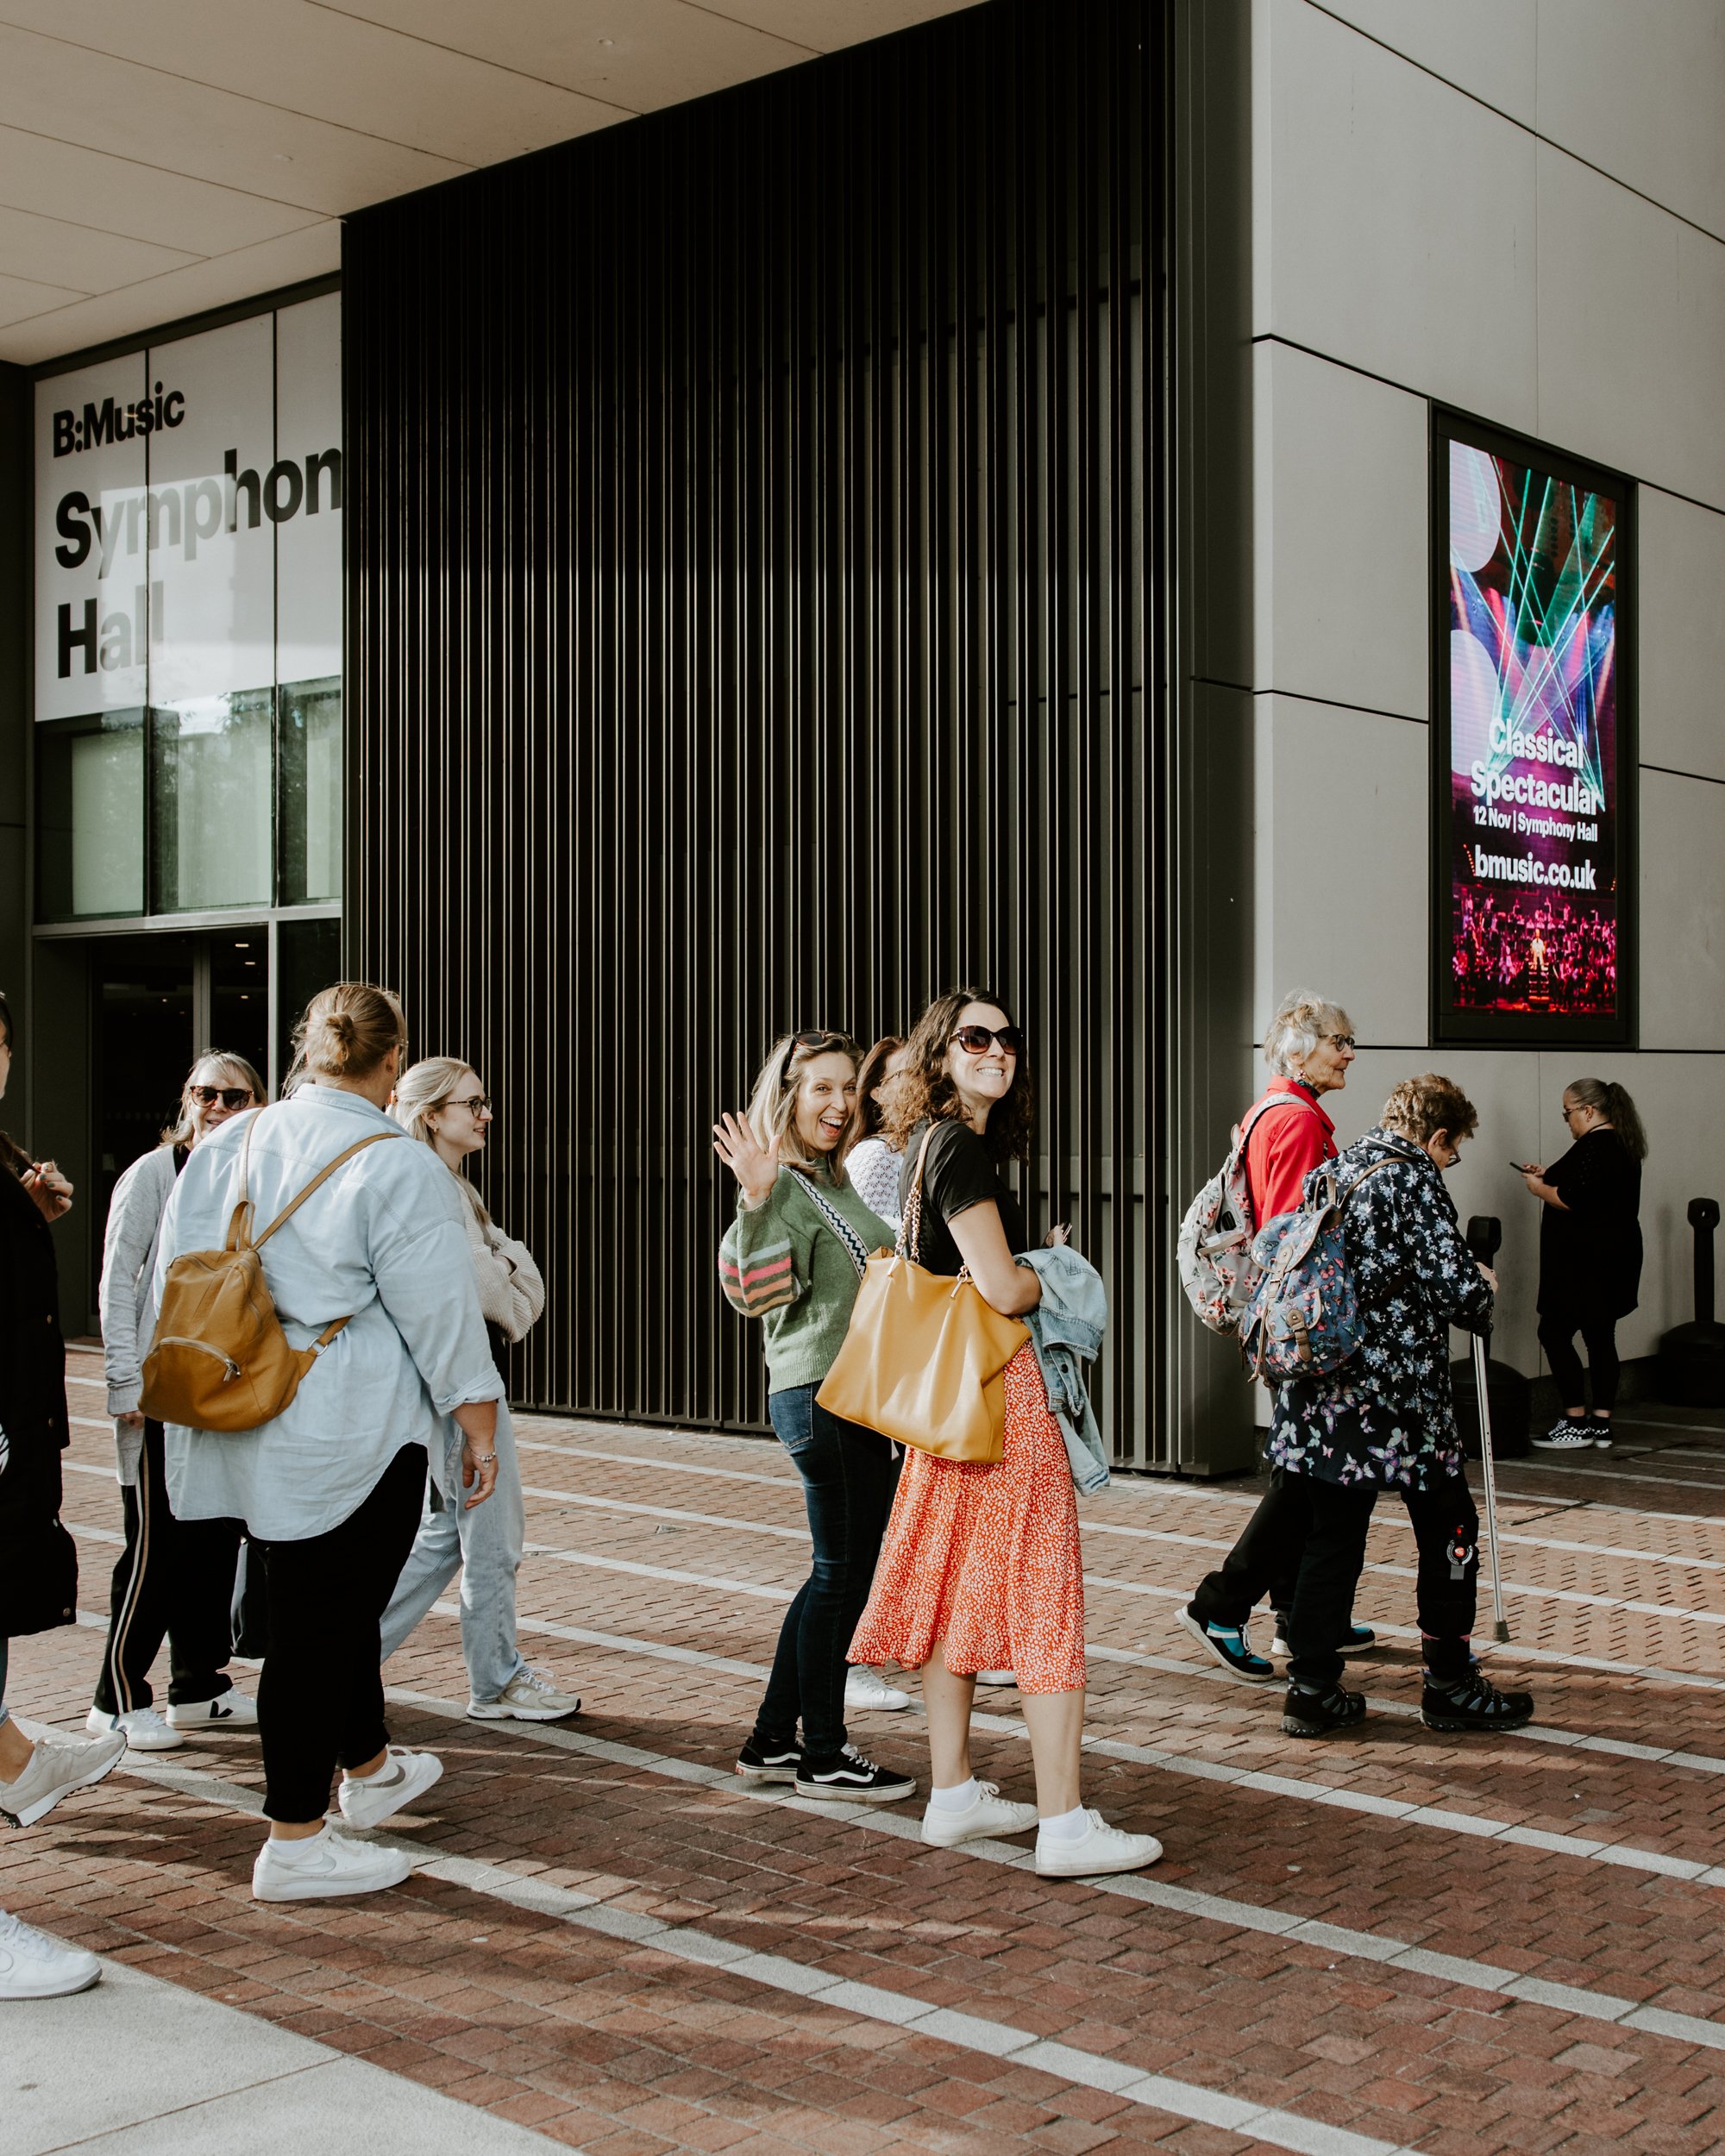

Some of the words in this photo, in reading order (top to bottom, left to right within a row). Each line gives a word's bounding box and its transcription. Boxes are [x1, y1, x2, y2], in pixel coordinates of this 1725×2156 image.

[53, 381, 185, 458] B:Music
[58, 581, 164, 679] Hall
[1490, 717, 1584, 769] Classical
[1471, 760, 1597, 816] Spectacular
[1473, 805, 1487, 825] 12
[1489, 808, 1511, 829] Nov
[1518, 812, 1576, 842] Symphony
[1577, 821, 1598, 842] Hall
[1475, 844, 1596, 891] bmusic.co.uk
